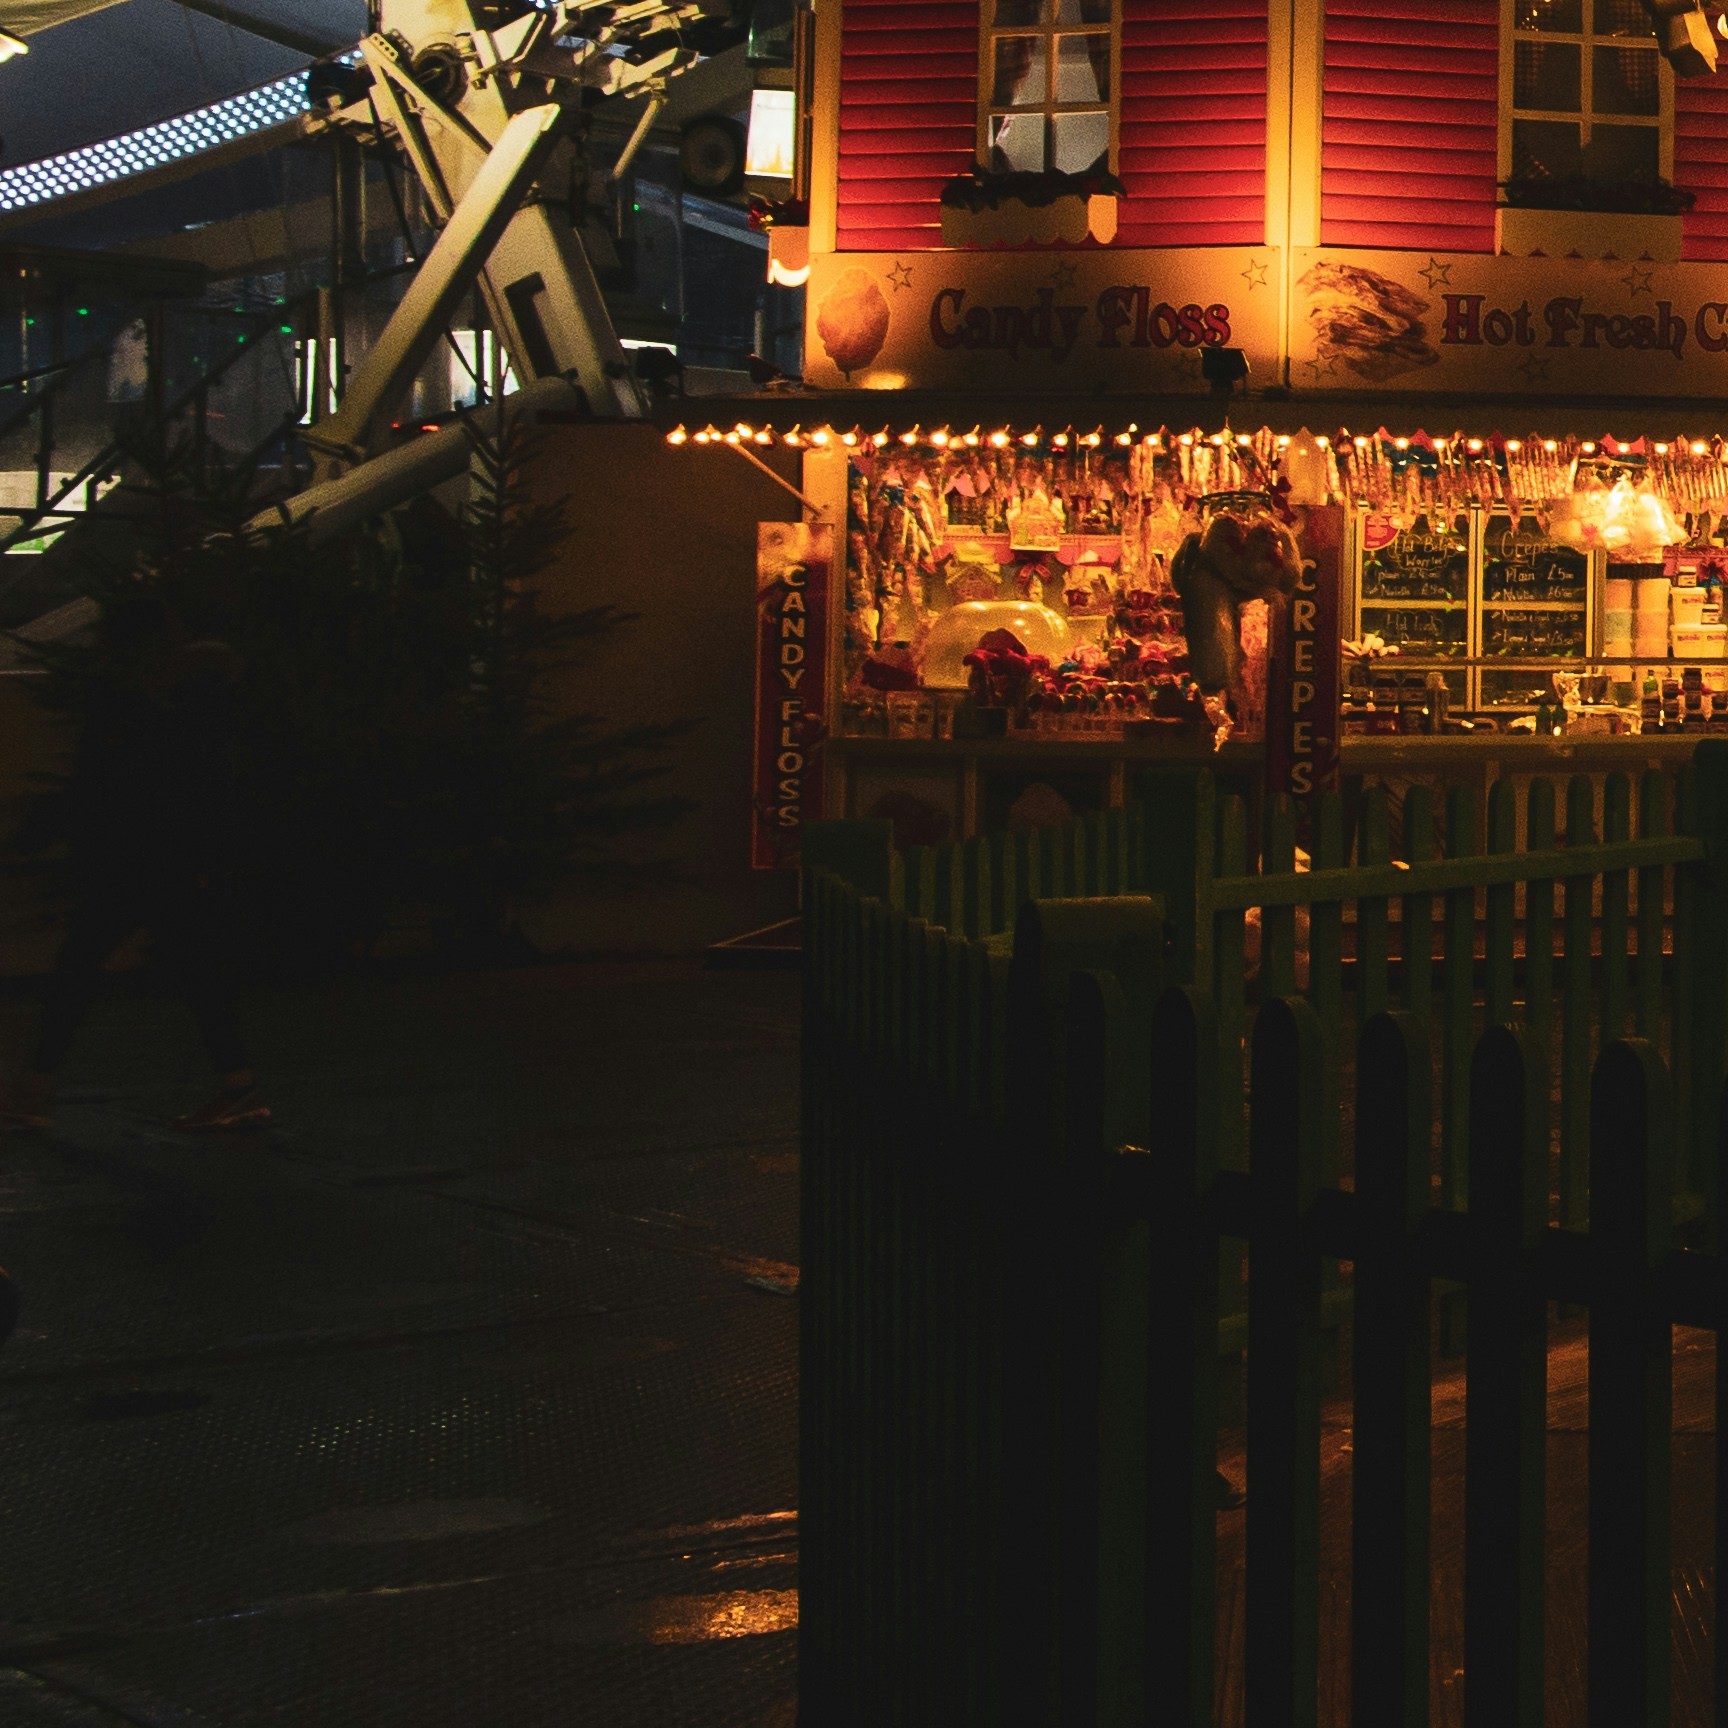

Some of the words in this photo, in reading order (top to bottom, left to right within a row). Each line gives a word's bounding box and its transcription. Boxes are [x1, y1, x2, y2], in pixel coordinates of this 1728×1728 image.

[929, 287, 1088, 364] Candy
[1095, 285, 1231, 349] Floss
[1440, 293, 1537, 346] Hot
[1543, 295, 1689, 361] Fresh
[1501, 530, 1560, 567] Crepes
[779, 564, 806, 691] CANDY
[1290, 558, 1318, 795] CREPES
[776, 700, 804, 829] FLOSS
